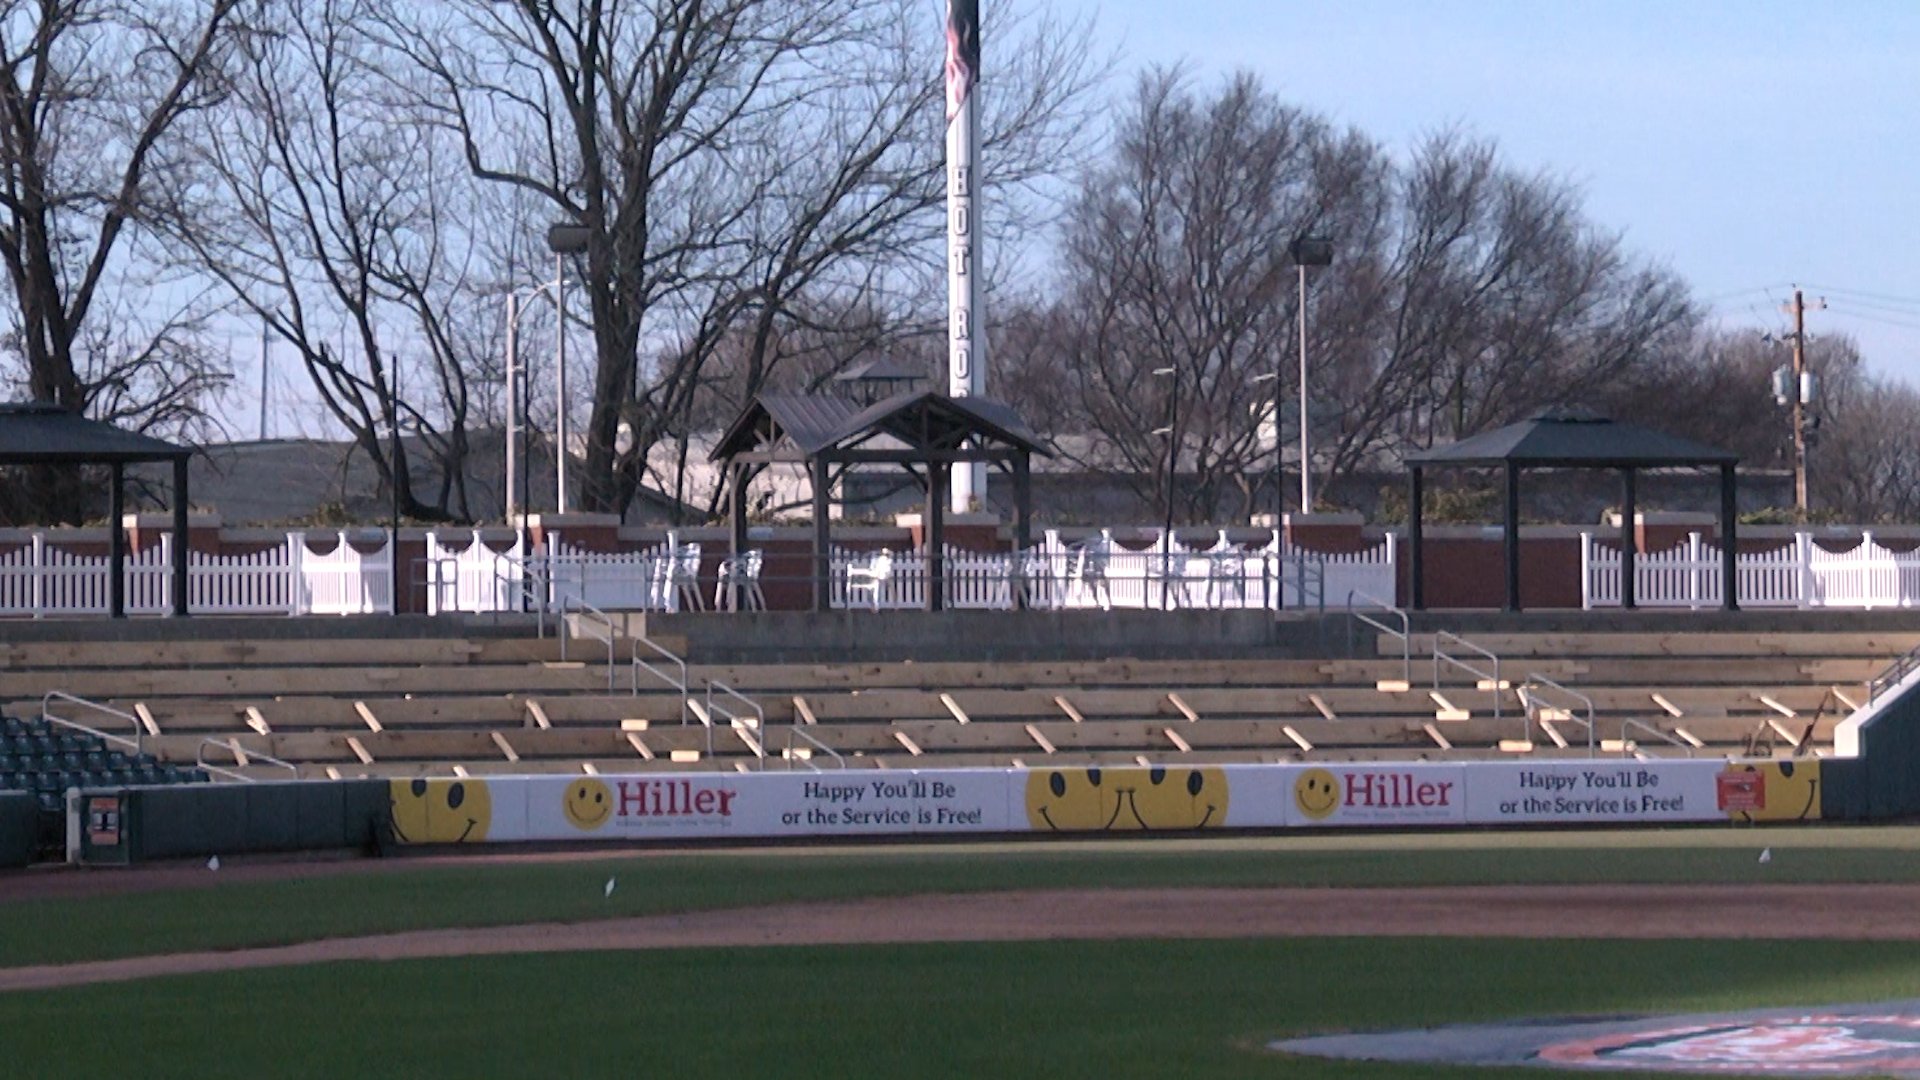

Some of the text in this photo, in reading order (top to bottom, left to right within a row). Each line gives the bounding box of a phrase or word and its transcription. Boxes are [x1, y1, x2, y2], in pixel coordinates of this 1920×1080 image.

[954, 307, 968, 398] RO
[1343, 773, 1453, 808] Hiller
[1519, 770, 1659, 790] Happy You'll Be
[616, 780, 736, 816] Hiller
[804, 781, 956, 802] Happy You'll Be
[1500, 795, 1684, 813] or the Service is Free!
[781, 807, 981, 824] or the Service is Free!
